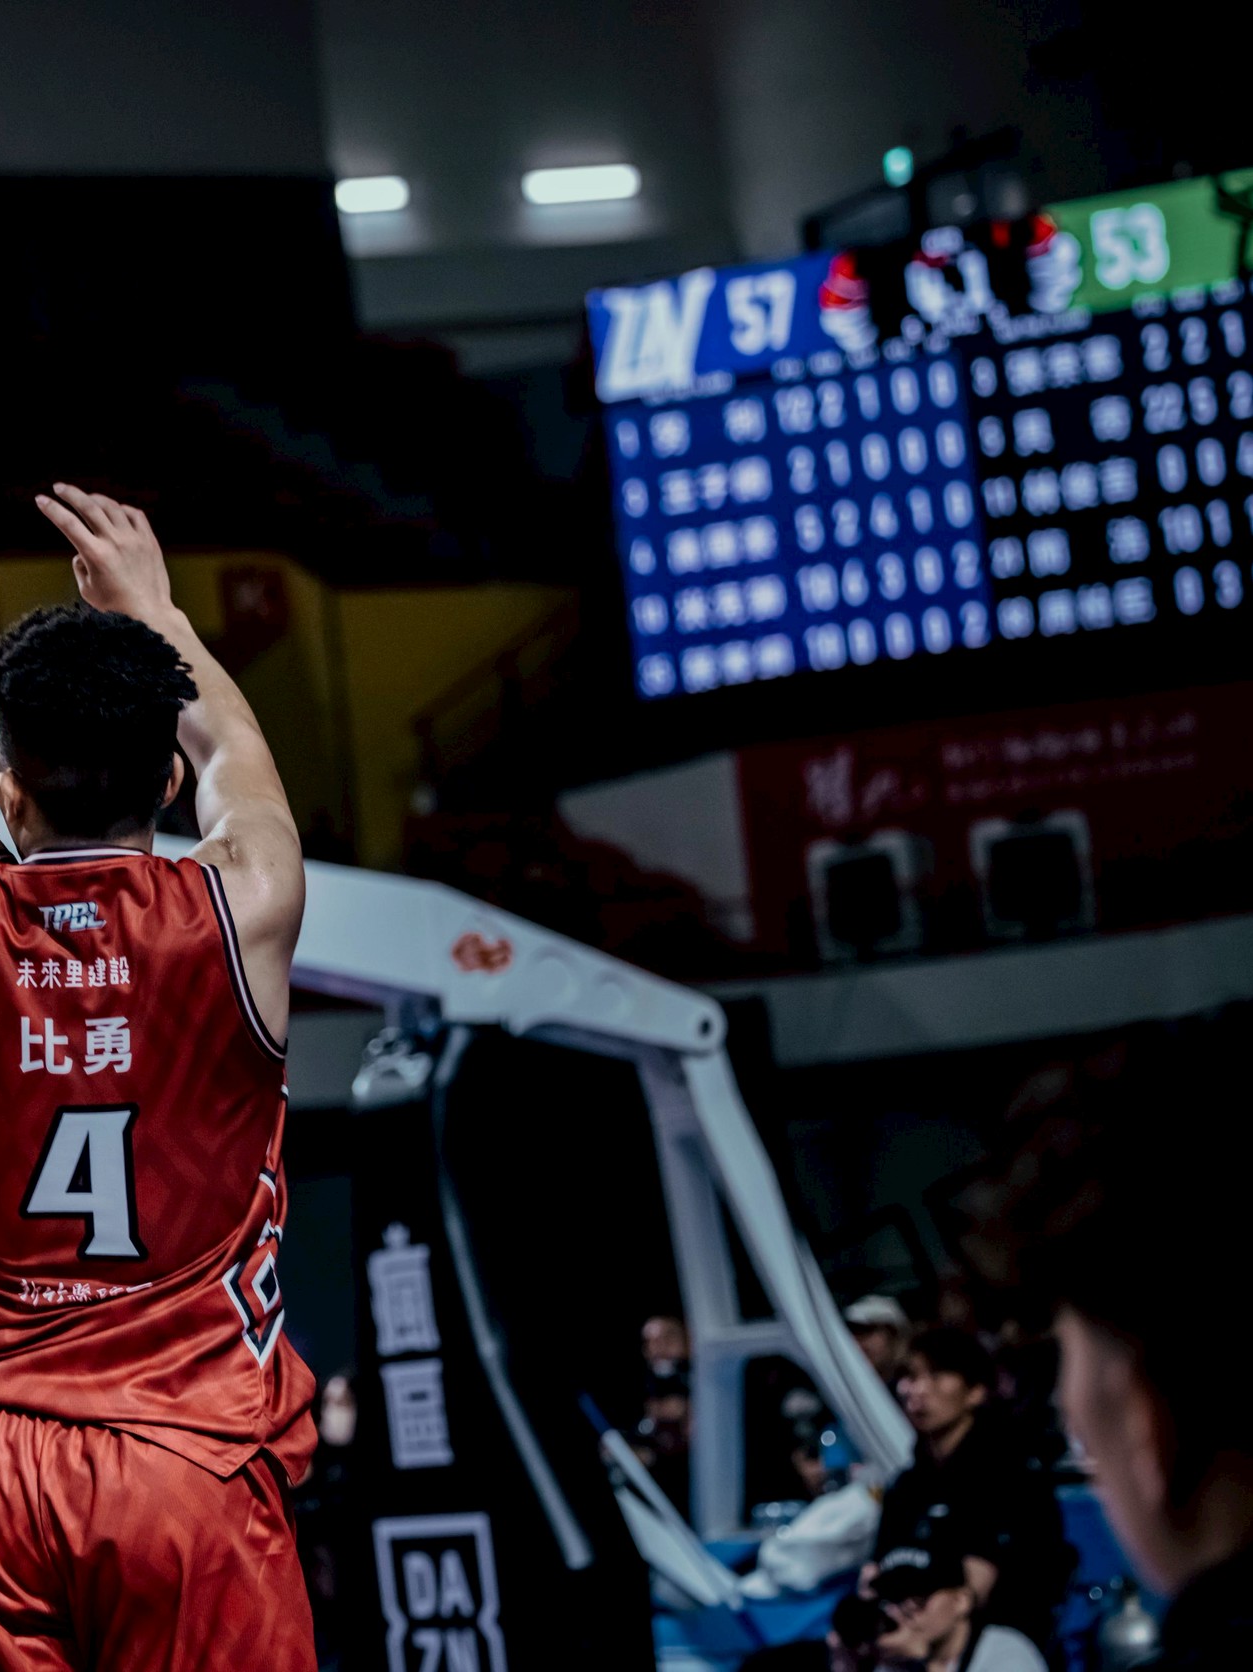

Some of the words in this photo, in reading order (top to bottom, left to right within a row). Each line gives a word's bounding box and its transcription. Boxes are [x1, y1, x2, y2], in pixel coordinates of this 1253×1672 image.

[1090, 203, 1170, 290] 53
[726, 272, 796, 354] 57
[38, 901, 107, 933] TPBL
[16, 956, 131, 989] 未來里建設
[19, 1016, 132, 1076] 比勇
[21, 1103, 146, 1260] 4
[402, 1550, 475, 1620] DA
